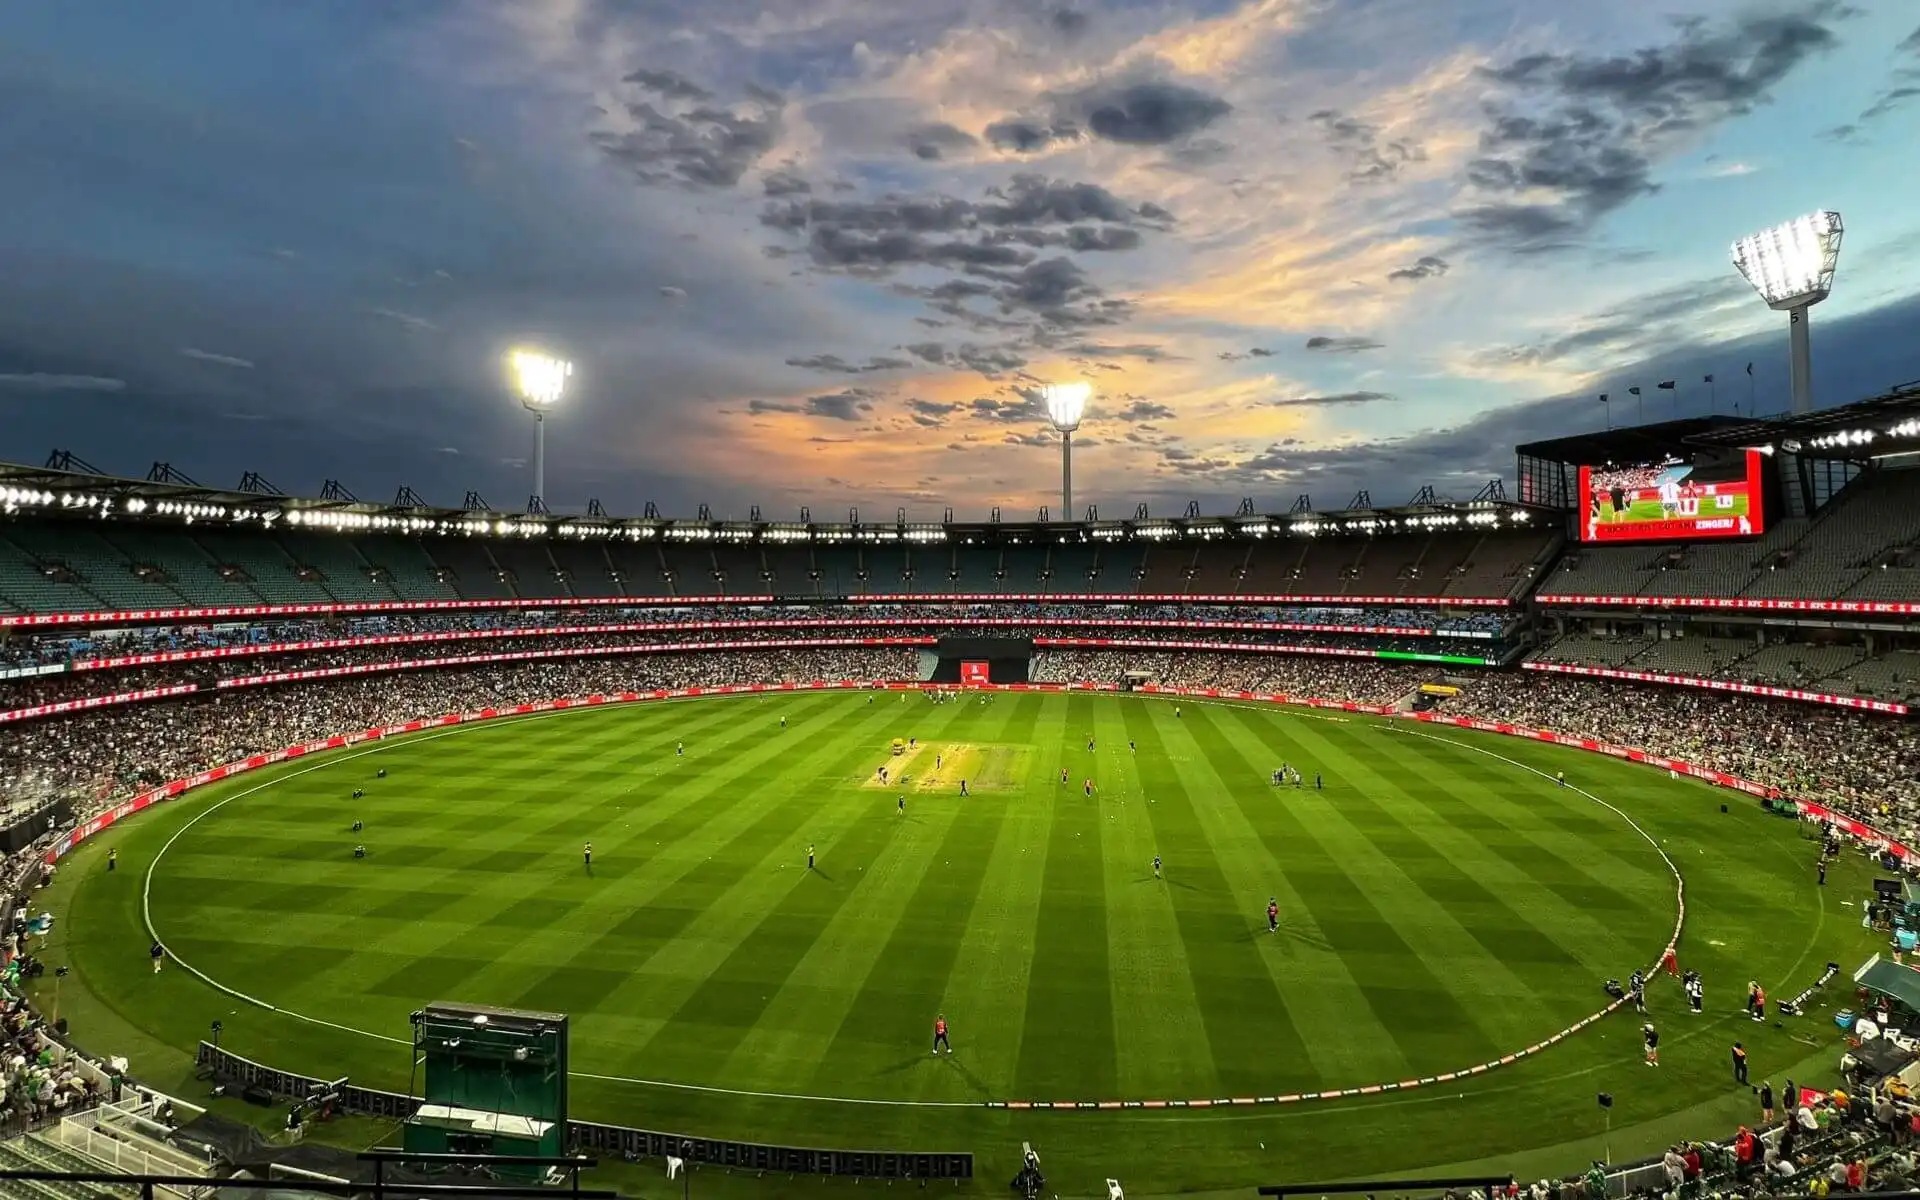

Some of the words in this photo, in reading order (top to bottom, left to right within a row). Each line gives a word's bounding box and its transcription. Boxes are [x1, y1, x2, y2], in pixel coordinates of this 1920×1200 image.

[1791, 312, 1799, 324] 5
[25, 708, 42, 716] KFC
[55, 703, 72, 711] KFC
[85, 698, 102, 706] KFC
[1836, 697, 1855, 705] KFC
[1873, 702, 1891, 710] KFC
